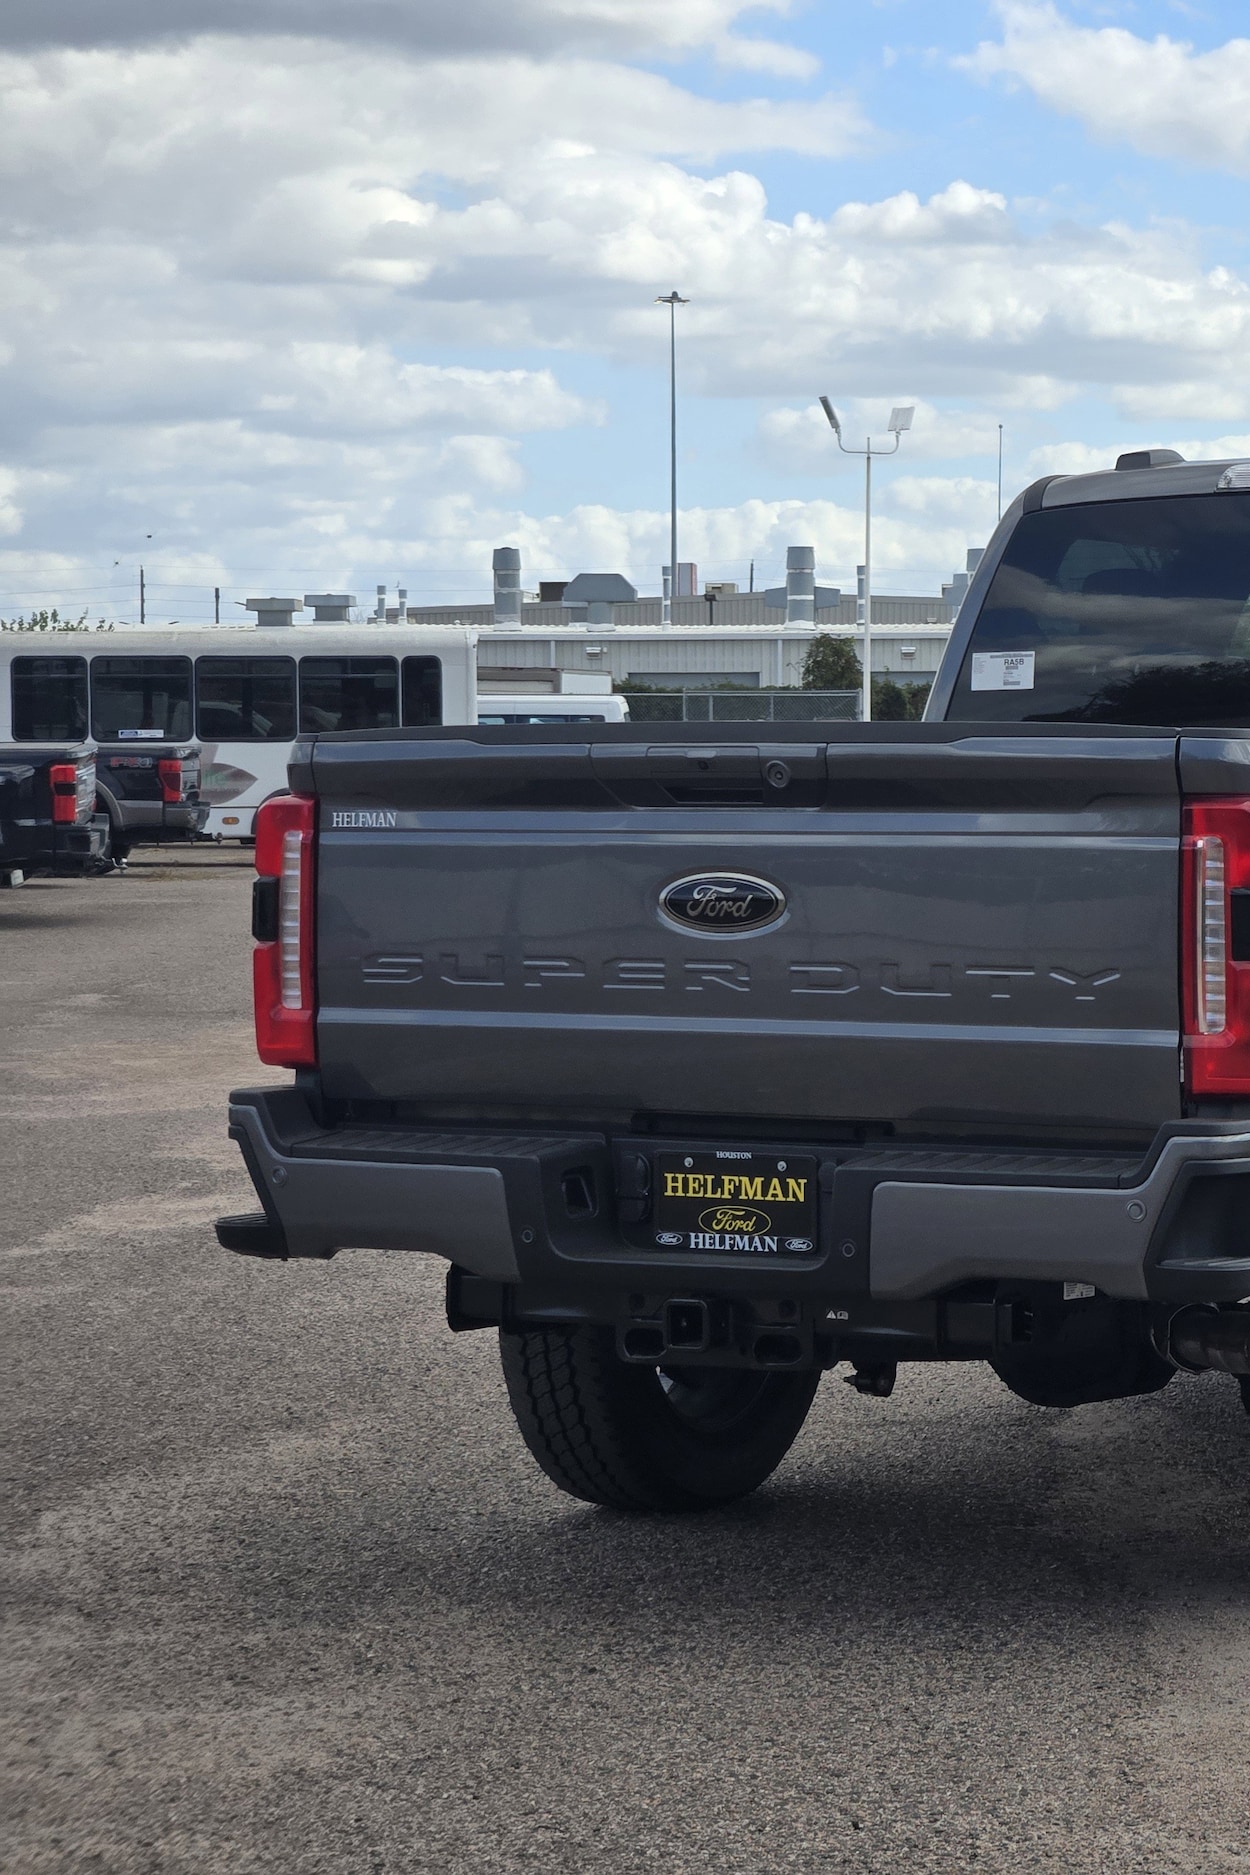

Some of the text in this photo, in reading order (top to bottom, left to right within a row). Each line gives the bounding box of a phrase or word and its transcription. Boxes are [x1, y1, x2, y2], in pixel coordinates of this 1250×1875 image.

[332, 812, 397, 828] HELFMAN
[687, 885, 754, 917] Ford
[362, 953, 1121, 1001] SUPER DUTY
[716, 1151, 752, 1159] HOUSTON
[664, 1173, 807, 1202] HELFMAN
[712, 1208, 757, 1232] Ford
[689, 1232, 778, 1252] HELFMAN
